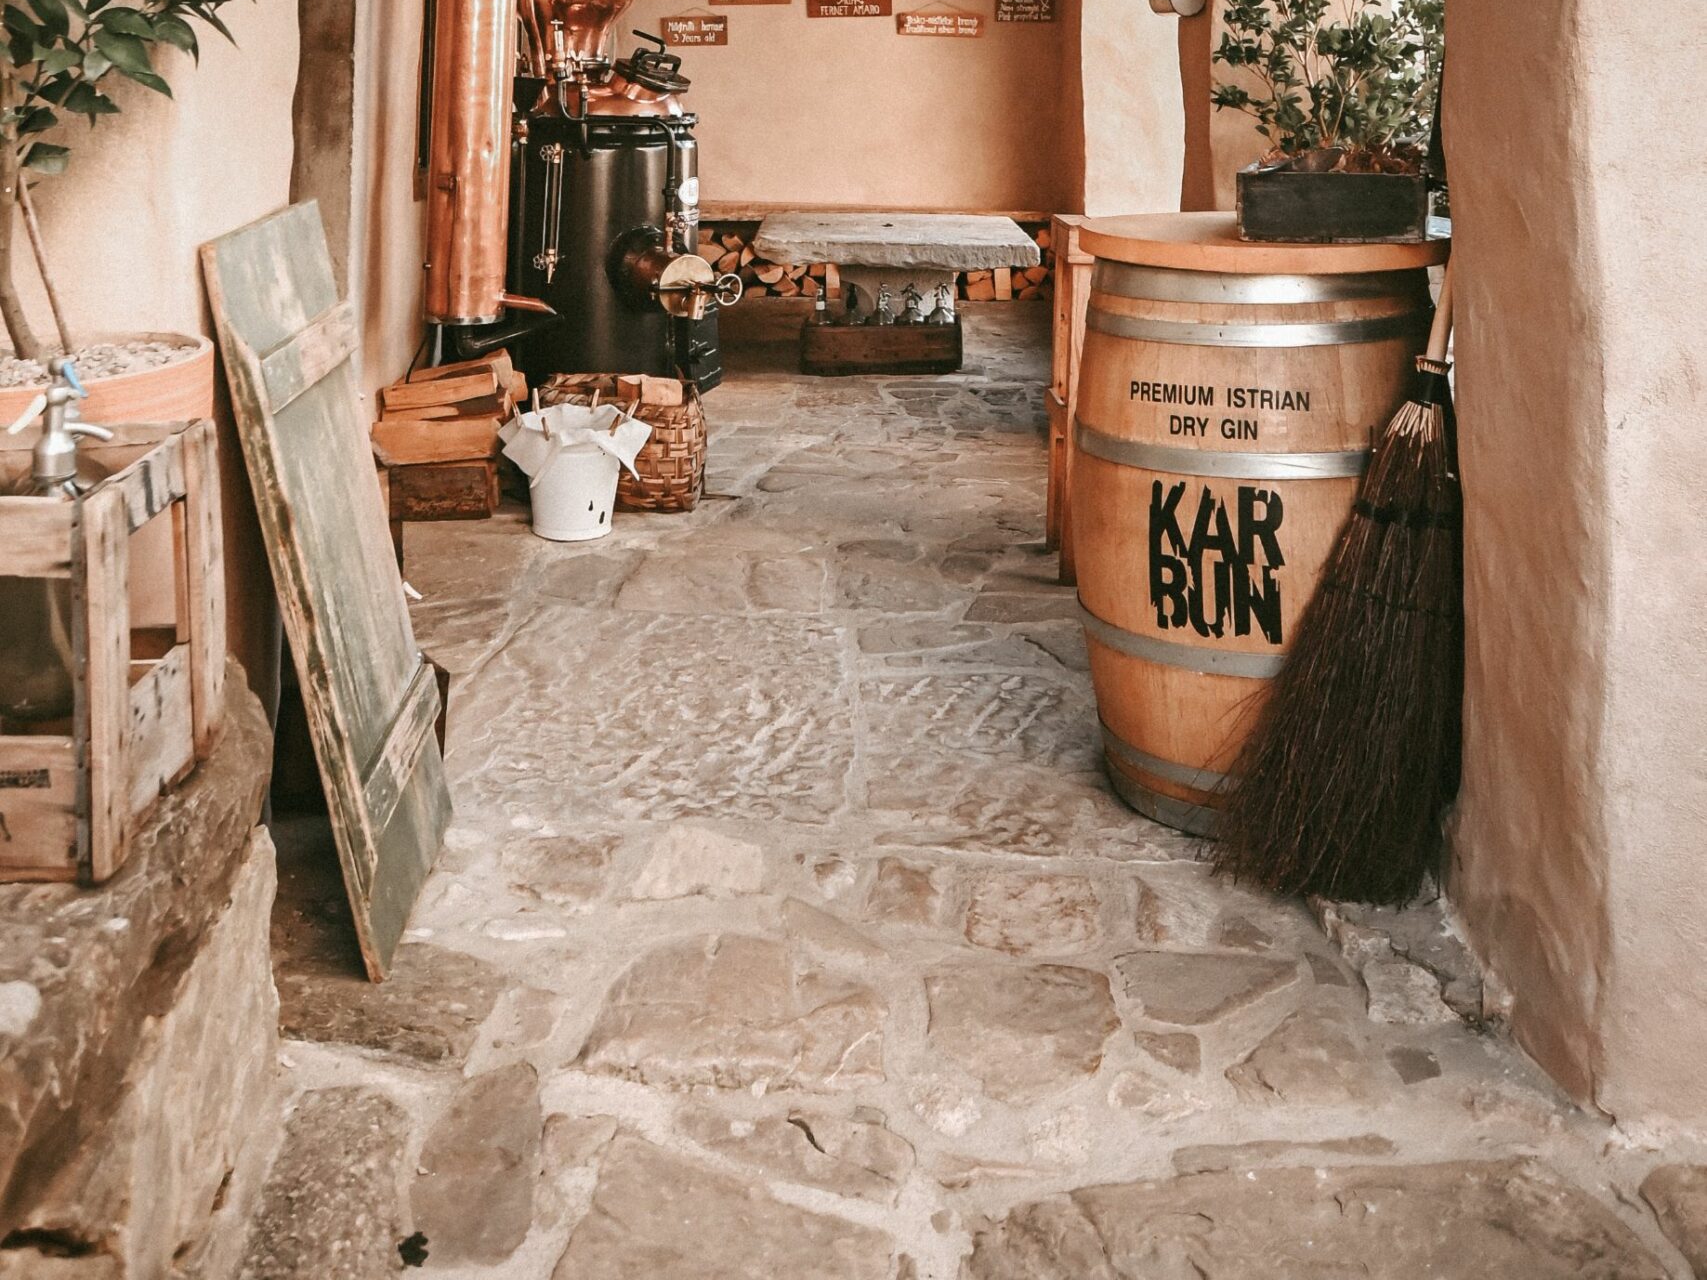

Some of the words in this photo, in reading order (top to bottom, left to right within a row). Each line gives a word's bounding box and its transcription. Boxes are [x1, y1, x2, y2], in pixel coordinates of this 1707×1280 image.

[820, 5, 848, 16] FERNET
[853, 5, 880, 15] AMARO
[673, 33, 679, 42] 3
[704, 32, 716, 42] old
[1130, 381, 1214, 406] PREMIUM
[1227, 388, 1310, 411] ISTRIAN
[1169, 415, 1209, 437] DRY
[1220, 419, 1258, 440] GIN
[1149, 480, 1286, 567] KAR
[1150, 553, 1283, 645] BUN
